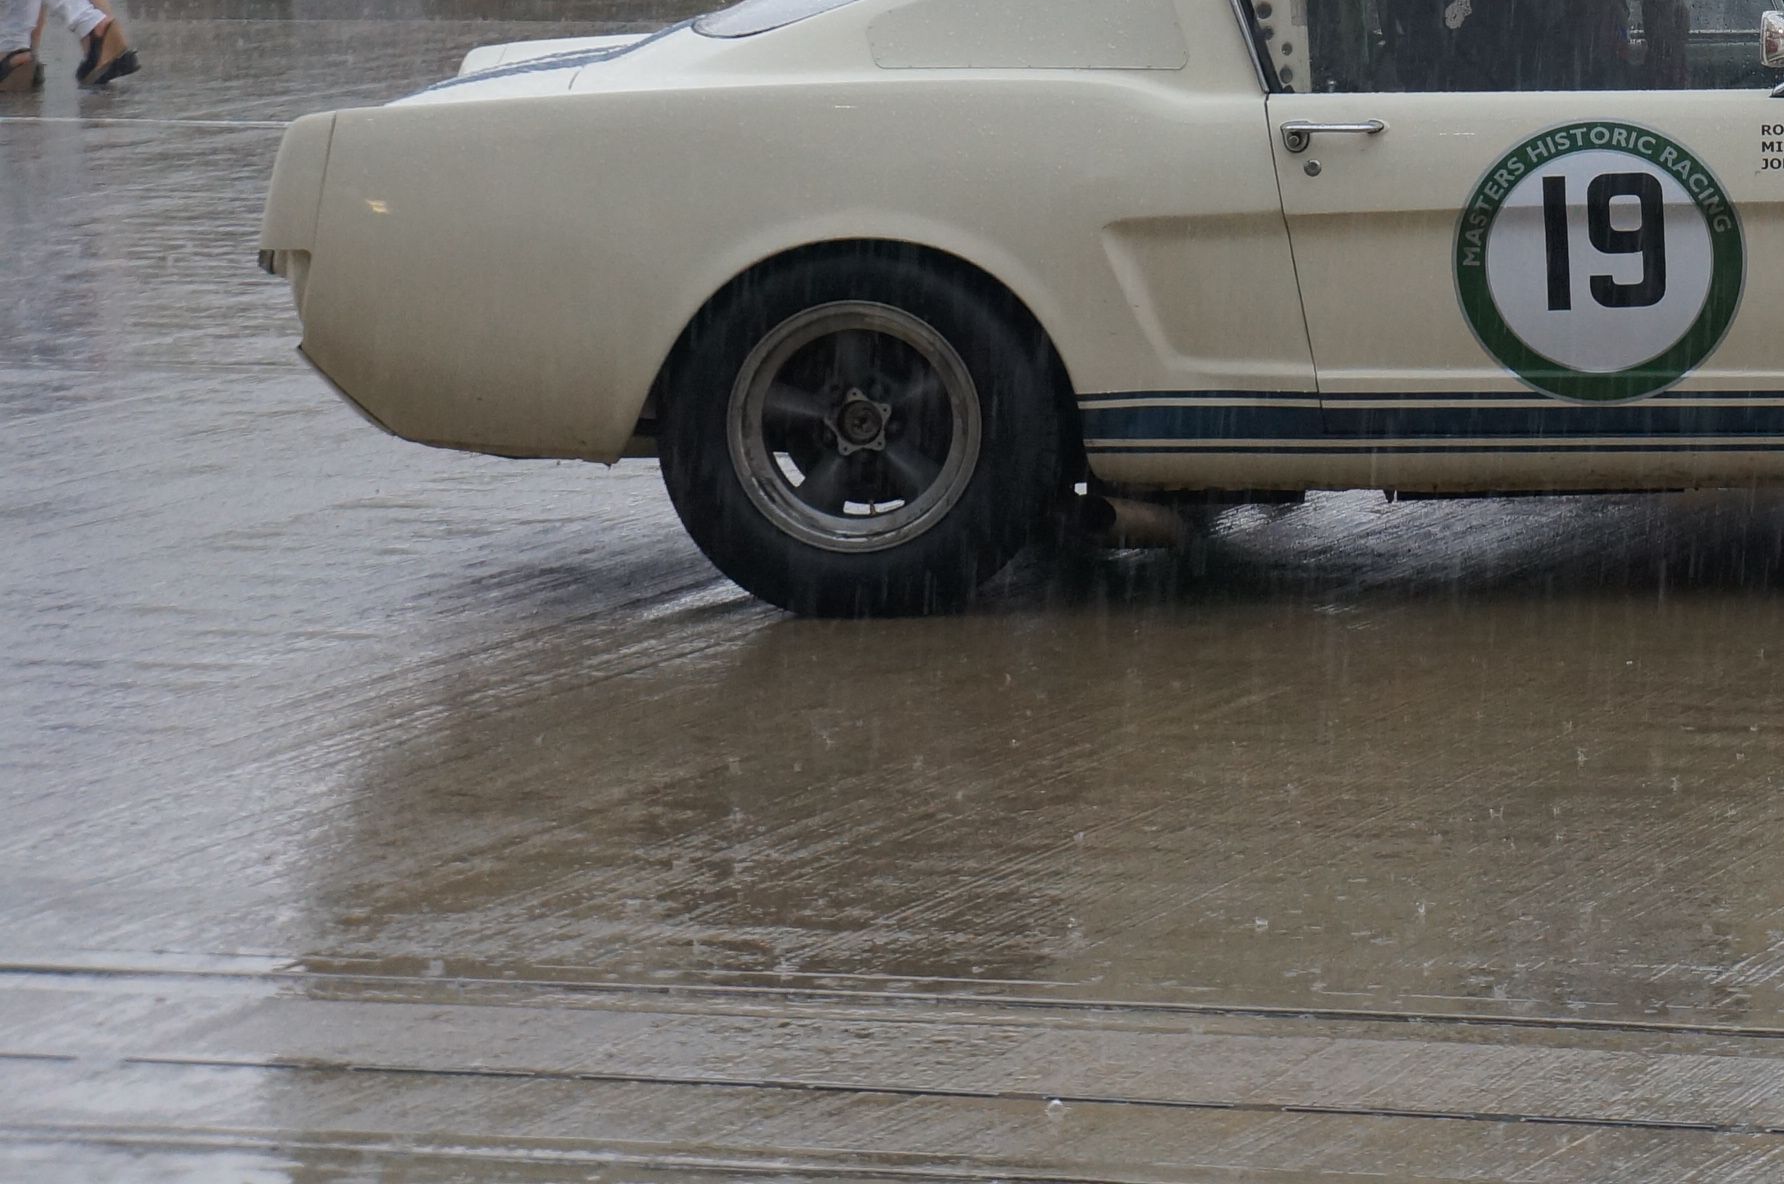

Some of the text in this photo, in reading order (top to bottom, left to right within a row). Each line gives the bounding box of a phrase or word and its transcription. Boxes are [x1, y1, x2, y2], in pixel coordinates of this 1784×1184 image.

[1462, 126, 1733, 267] MASTERS HISTORIC RACING
[1542, 171, 1667, 311] 19
